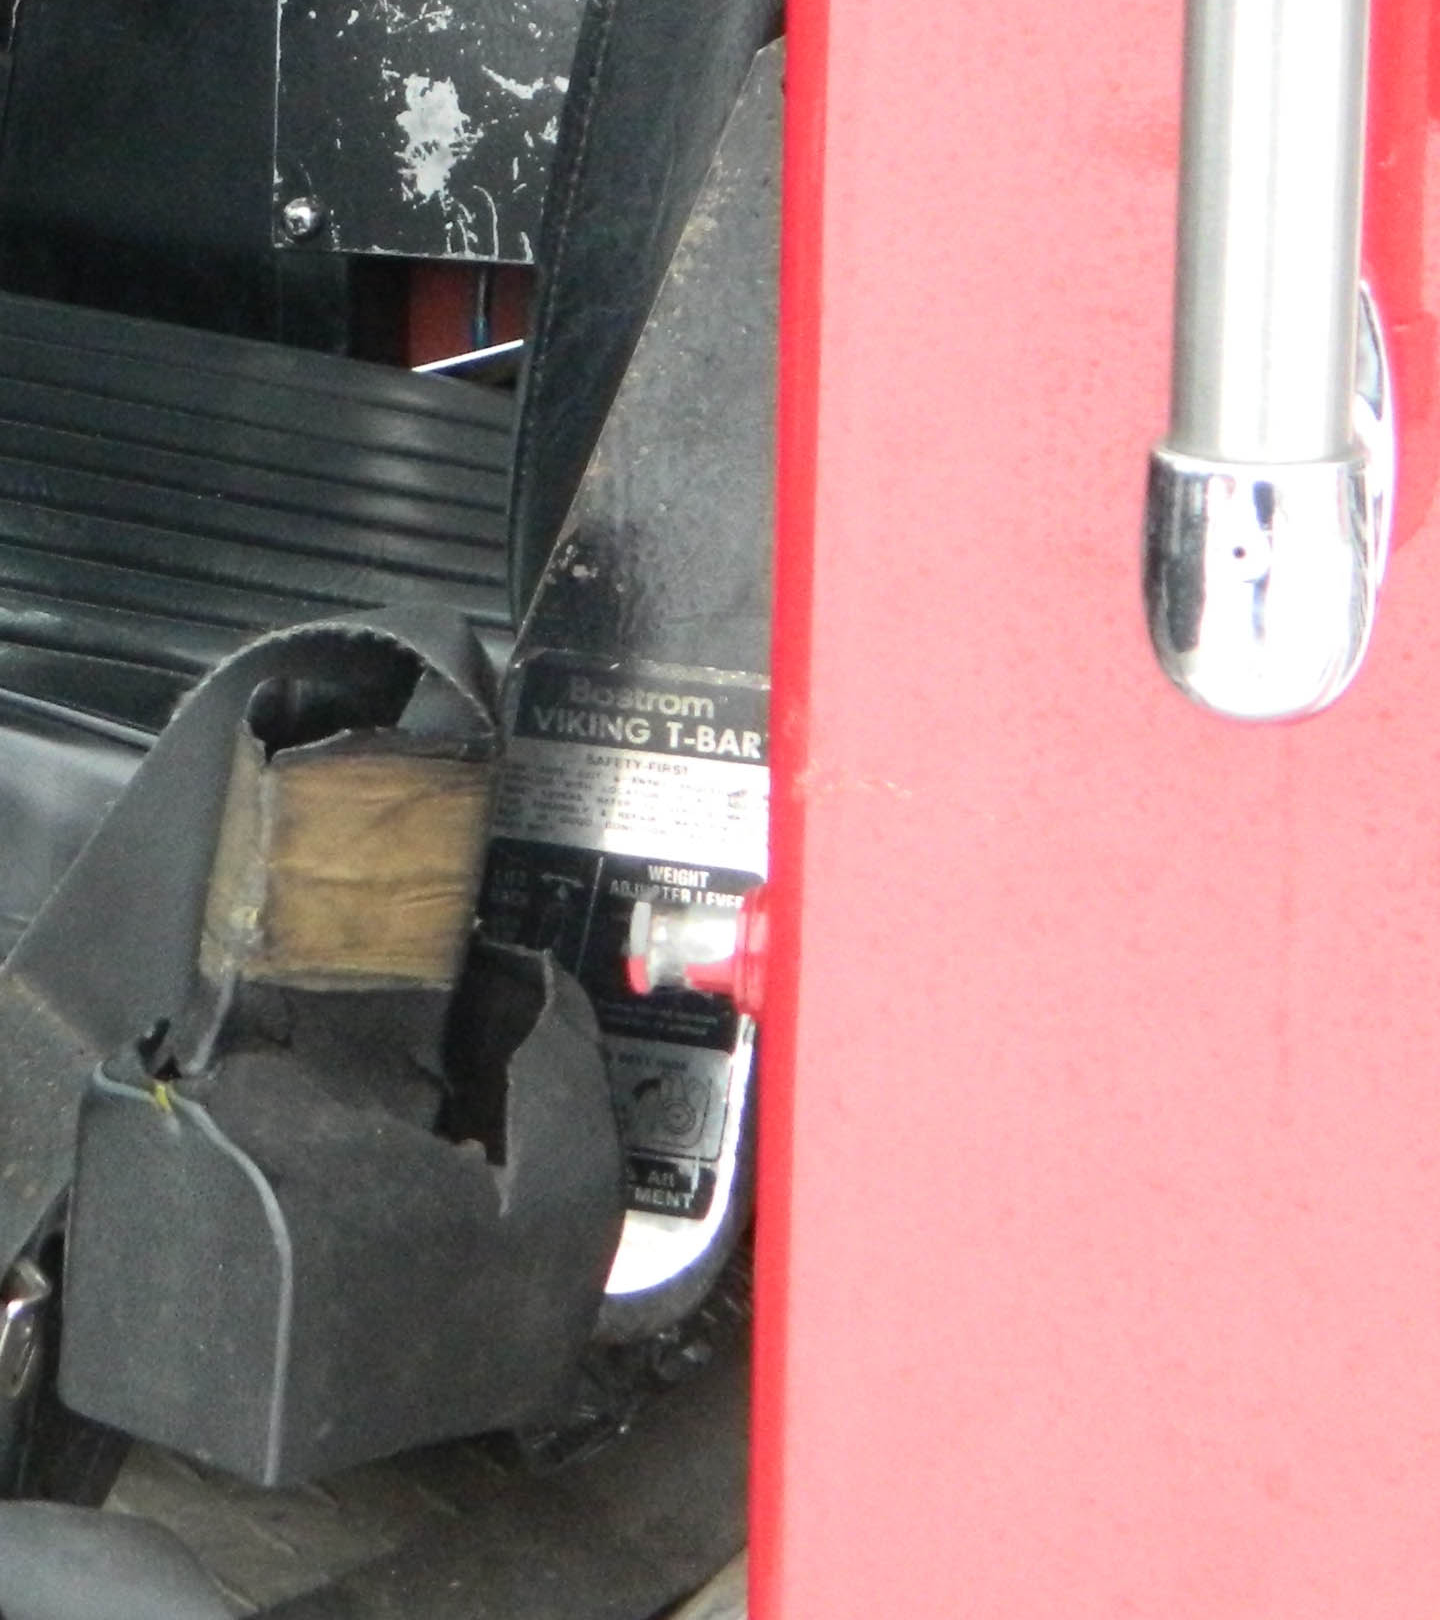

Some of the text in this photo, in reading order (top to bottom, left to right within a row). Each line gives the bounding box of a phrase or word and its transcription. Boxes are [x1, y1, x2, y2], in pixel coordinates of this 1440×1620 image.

[570, 676, 714, 719] Bostrom
[533, 705, 762, 759] VIKING T-BAR
[648, 864, 710, 888] WEIGHT
